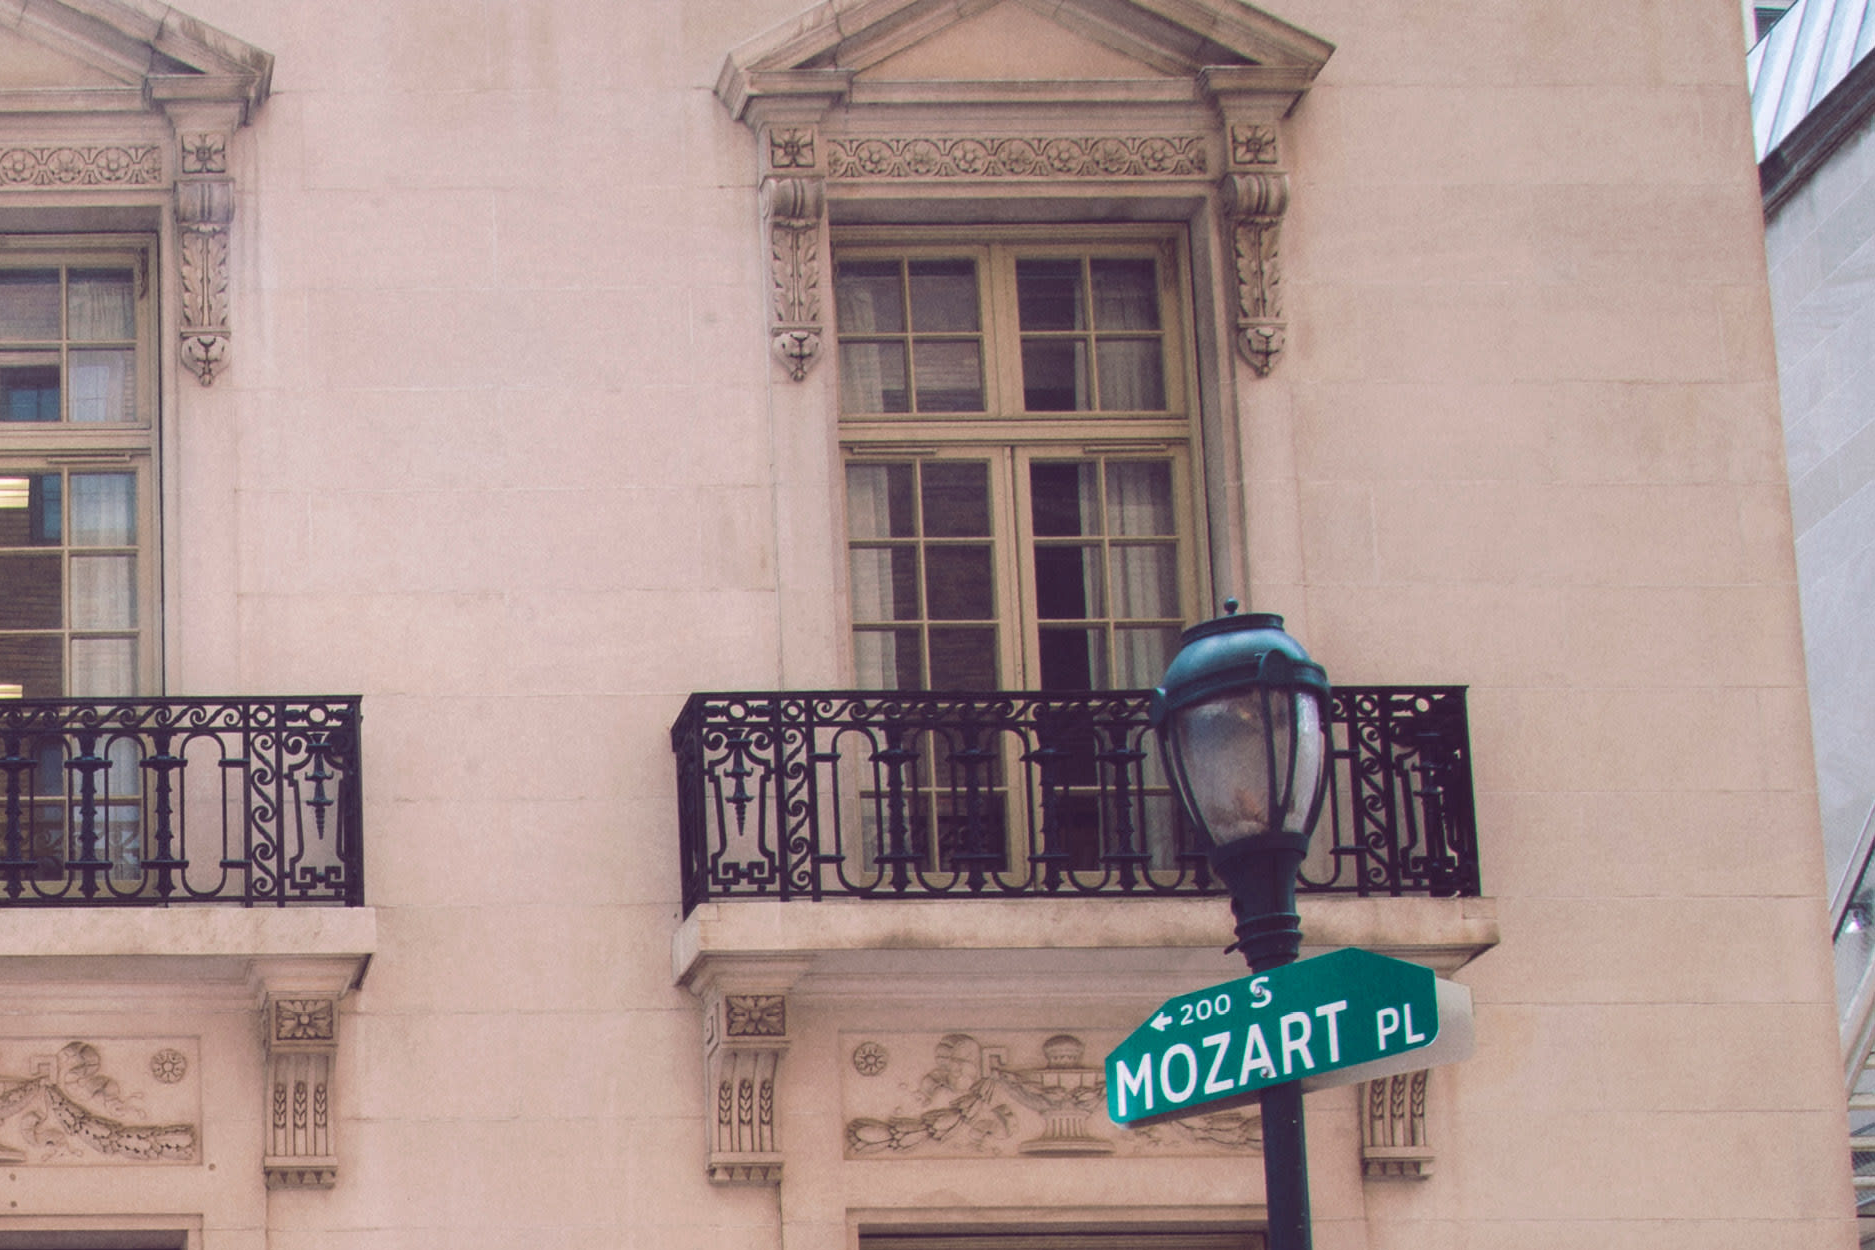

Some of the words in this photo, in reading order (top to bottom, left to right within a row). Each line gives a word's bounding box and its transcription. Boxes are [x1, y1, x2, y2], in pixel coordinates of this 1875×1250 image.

[1180, 994, 1232, 1026] 200
[1249, 976, 1273, 1009] S
[1115, 1000, 1349, 1118] MOZART
[1376, 1003, 1426, 1052] PL
